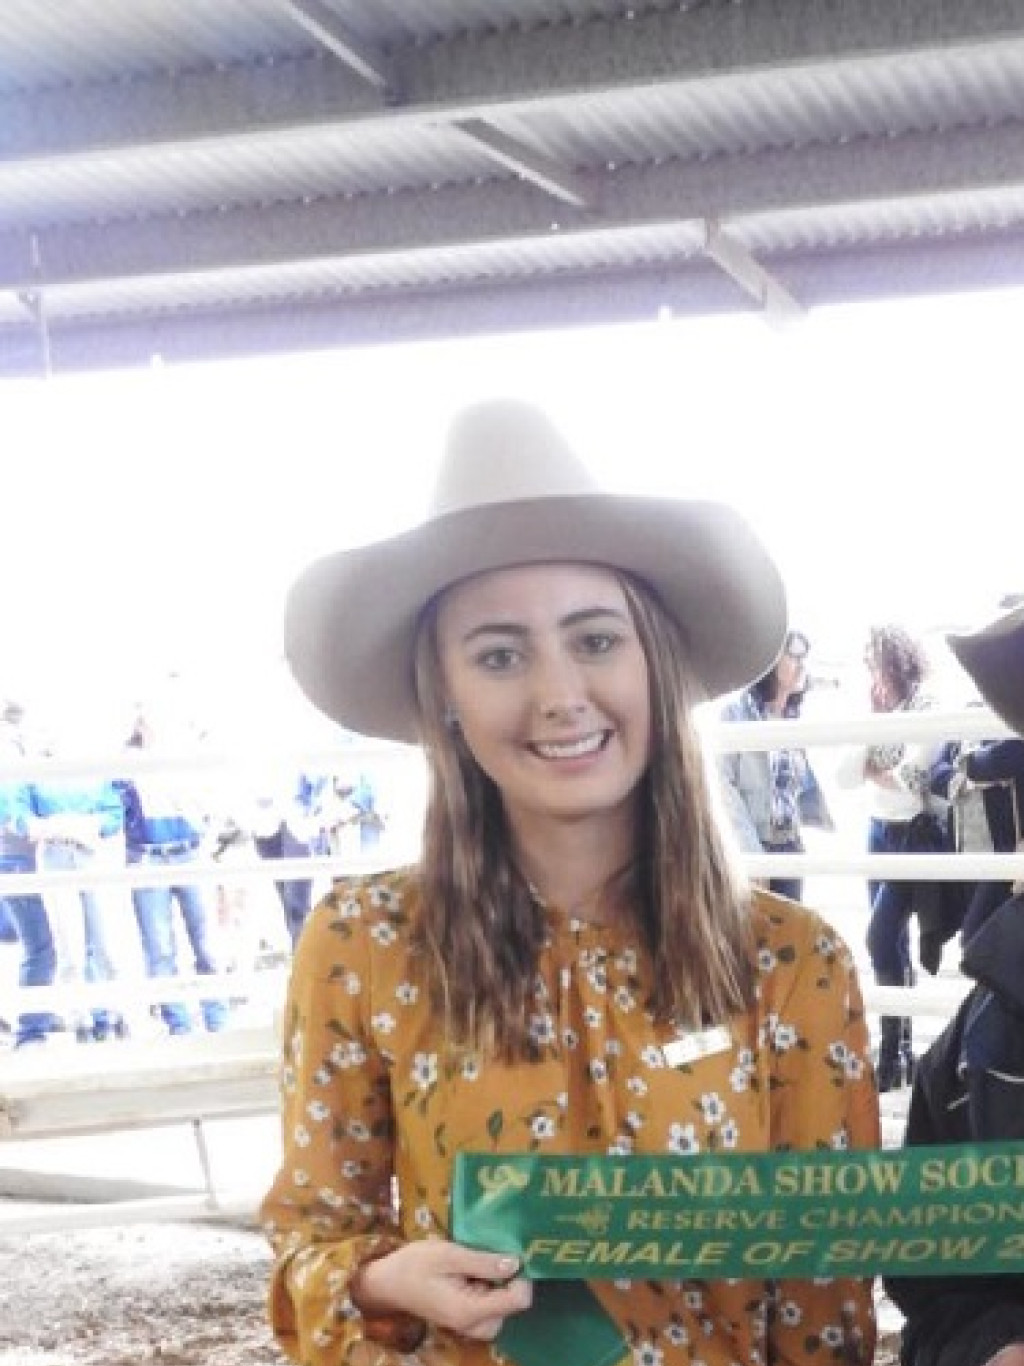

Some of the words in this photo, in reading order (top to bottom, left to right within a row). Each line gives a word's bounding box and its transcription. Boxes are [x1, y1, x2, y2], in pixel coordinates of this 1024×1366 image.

[540, 1165, 762, 1197] MALANDA
[774, 1160, 908, 1196] SHOW
[627, 1209, 786, 1230] RESERVE
[526, 1239, 733, 1265] FEMALE
[743, 1239, 816, 1264] OF
[825, 1235, 988, 1263] SHOW
